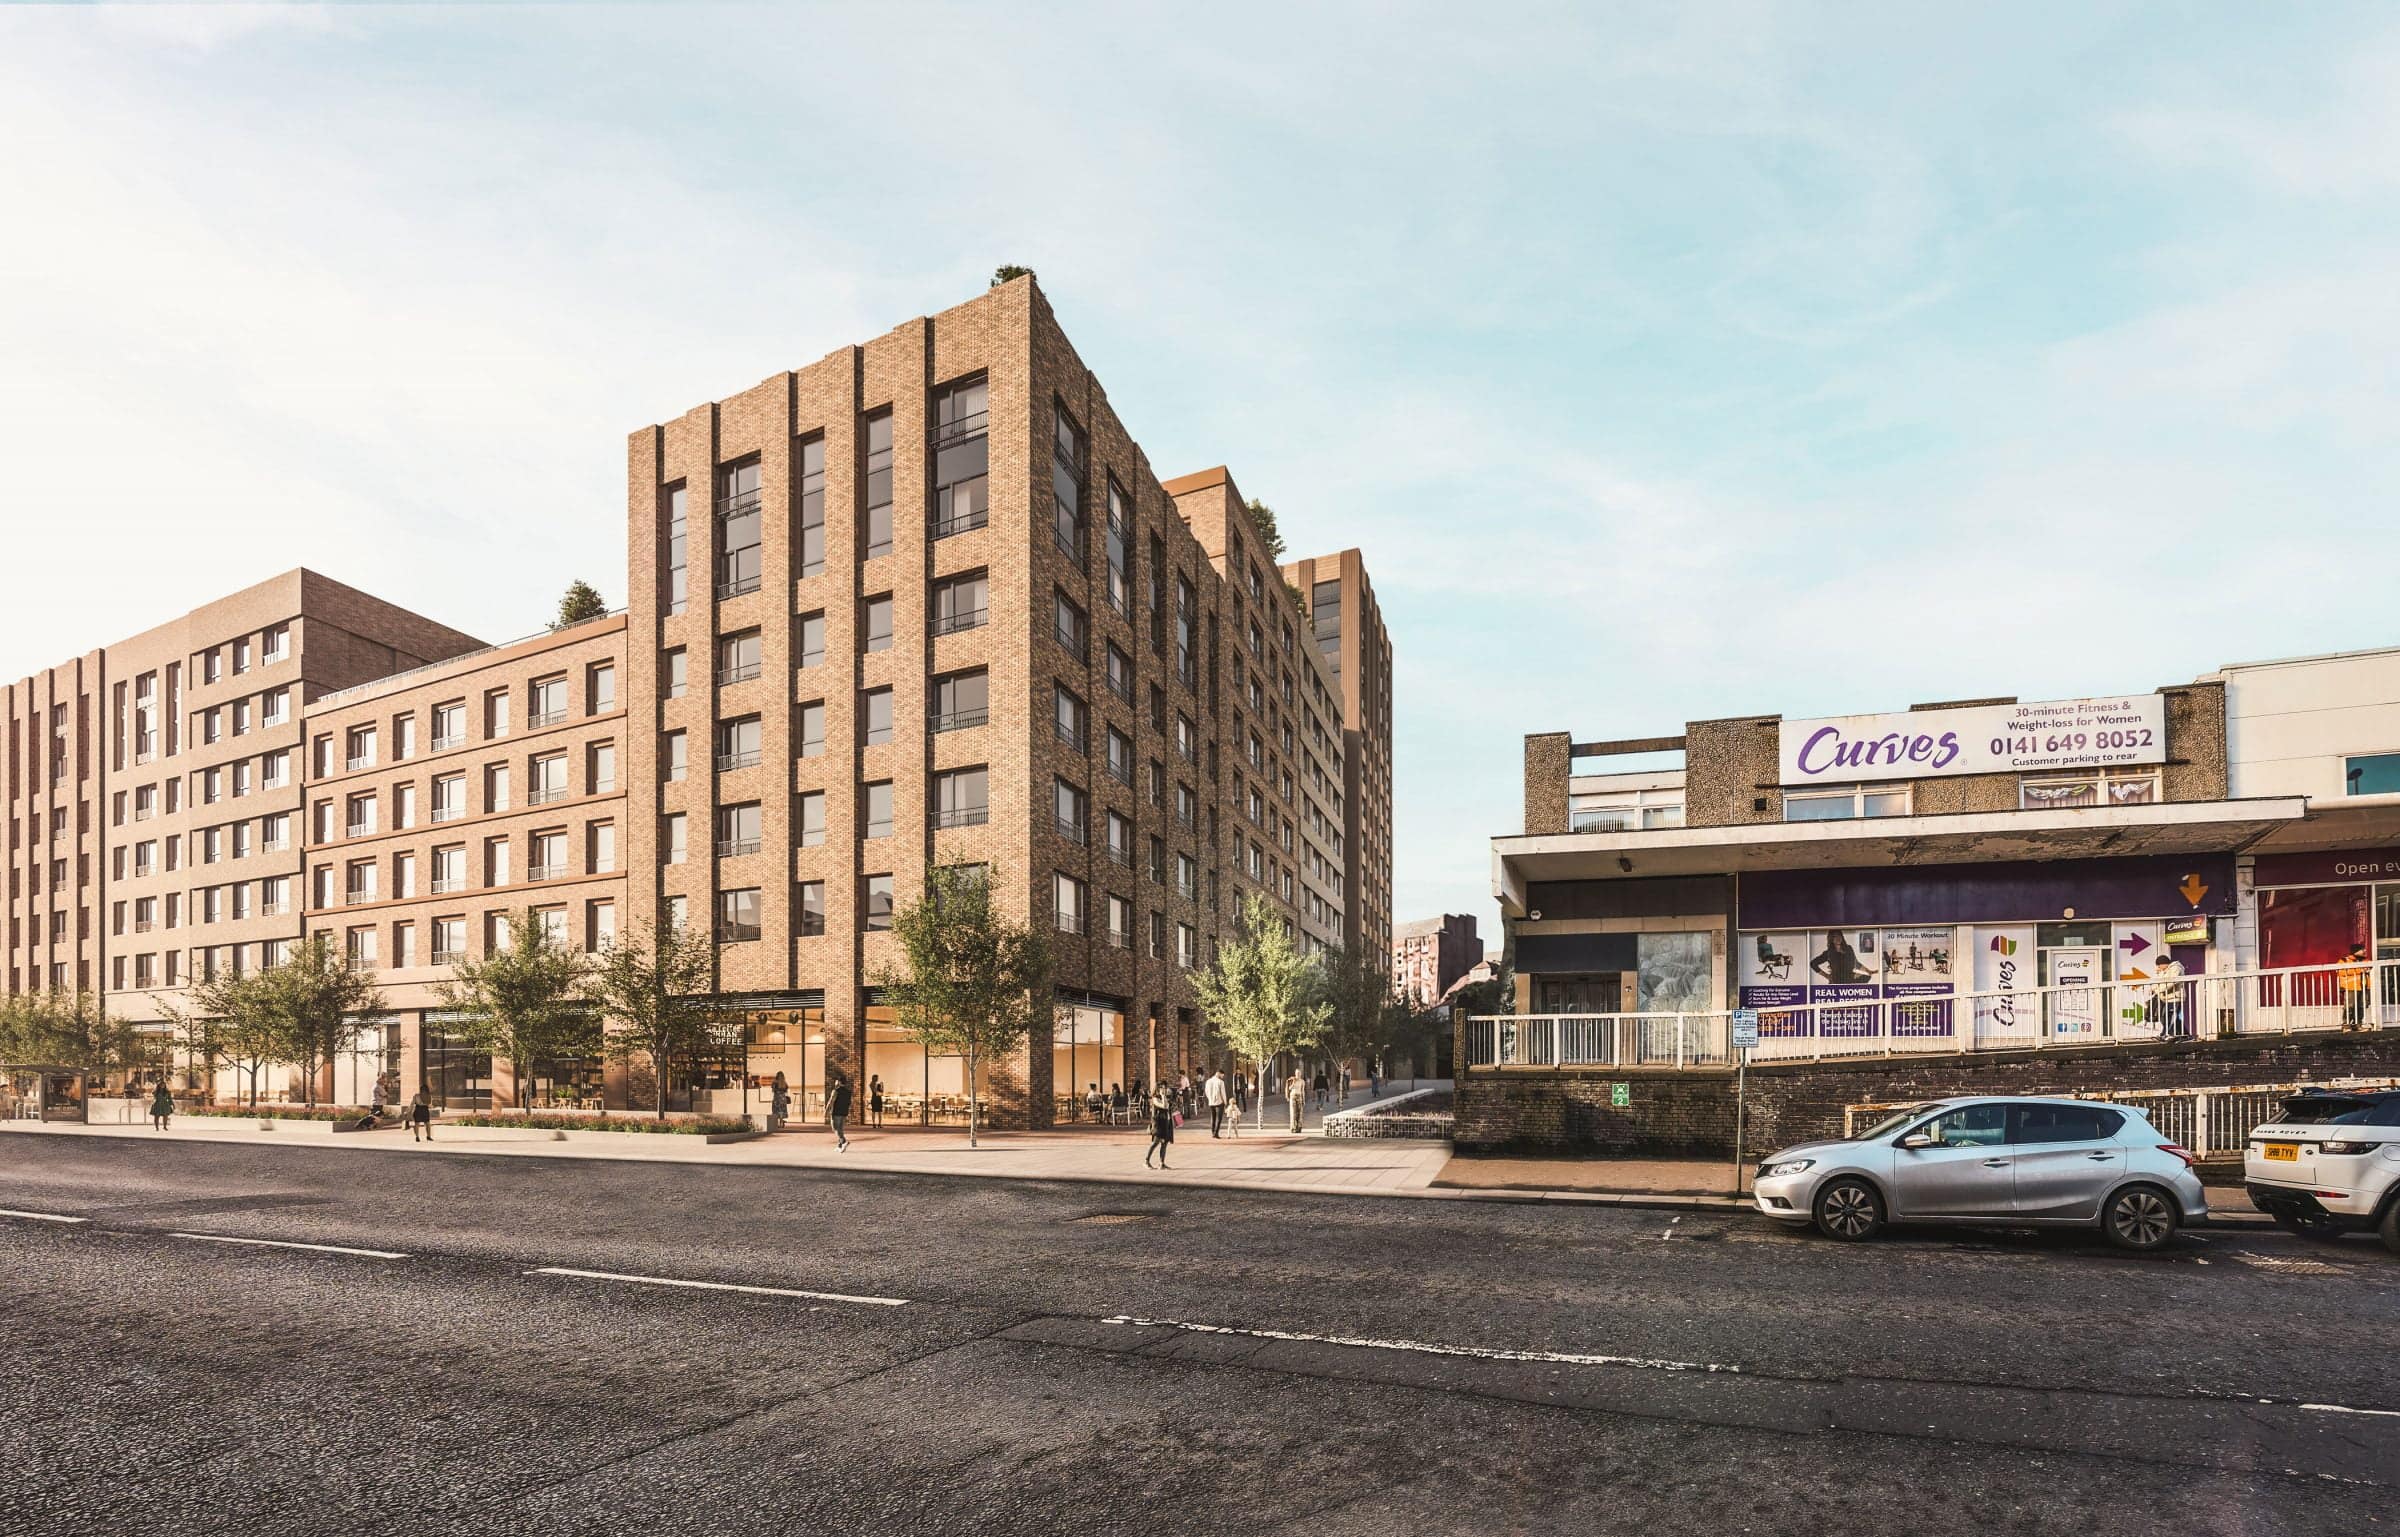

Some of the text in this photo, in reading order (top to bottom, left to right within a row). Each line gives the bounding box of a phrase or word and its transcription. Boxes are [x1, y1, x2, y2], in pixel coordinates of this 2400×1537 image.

[2015, 701, 2131, 718] 30-minute Fitness &
[2007, 715, 2142, 732] Weight-loss for Women
[1990, 729, 2153, 755] 0141 649 8052
[1797, 726, 1960, 774] Curves
[2012, 757, 2060, 766] Customer
[2062, 754, 2100, 765] parking
[2335, 863, 2379, 877] Open
[1815, 988, 1873, 997] REAL WOMEN
[1617, 1097, 1624, 1105] 2
